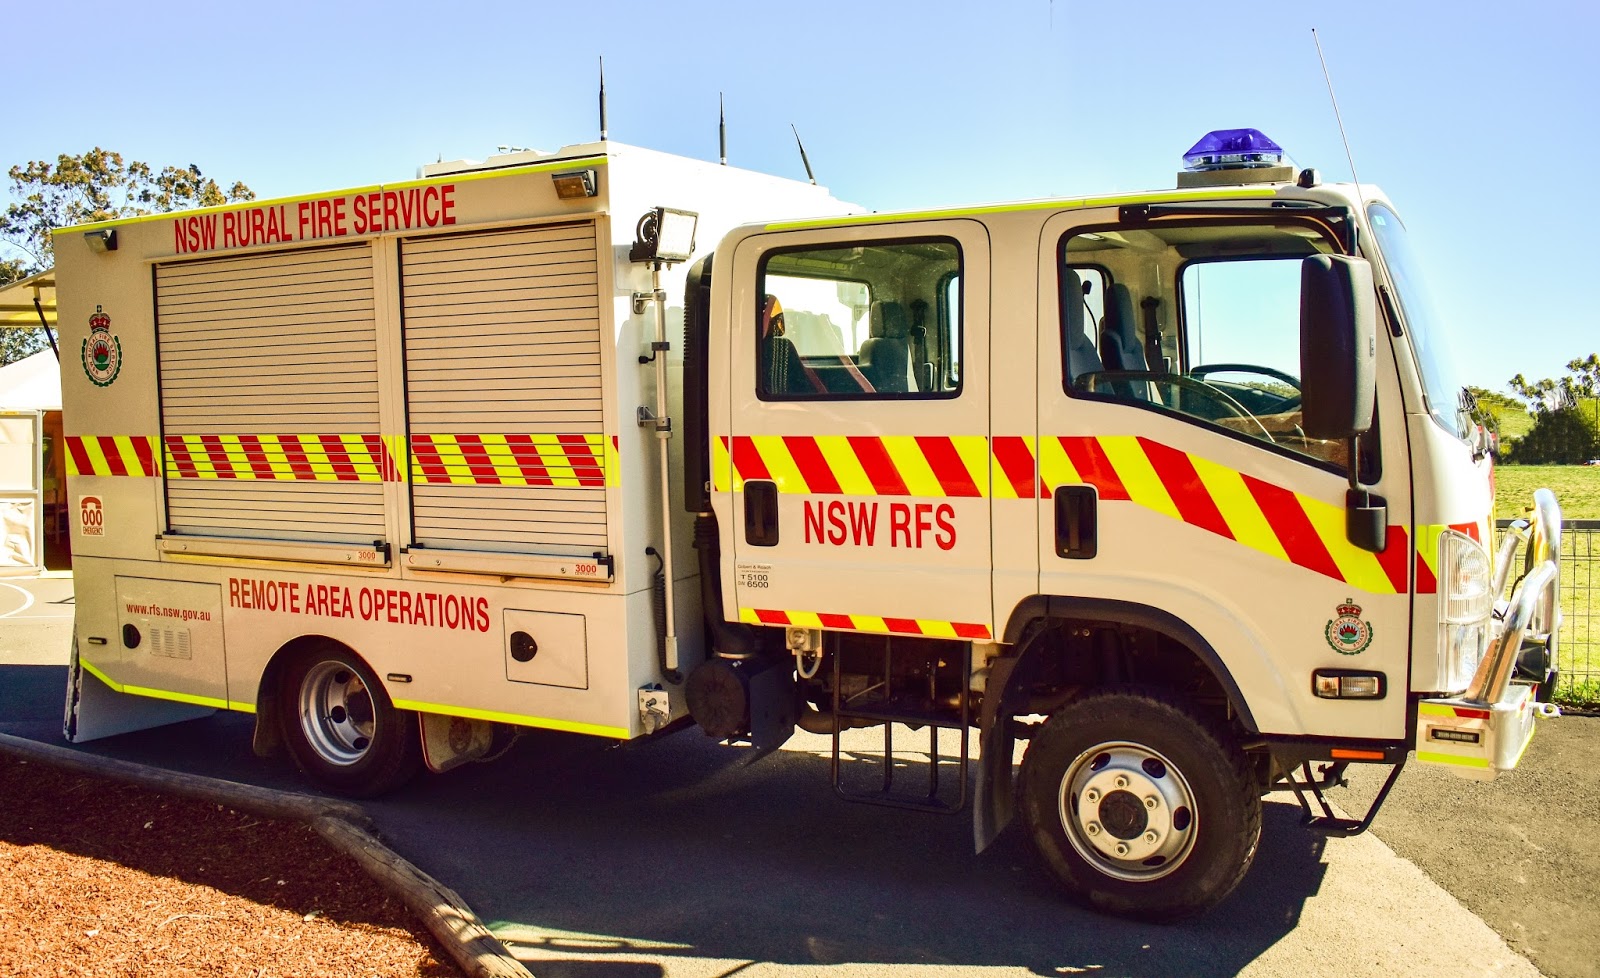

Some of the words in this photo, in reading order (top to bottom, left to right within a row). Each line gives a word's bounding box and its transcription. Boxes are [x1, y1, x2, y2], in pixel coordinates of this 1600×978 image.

[175, 214, 217, 254] NSW
[223, 205, 293, 249] RURAL
[298, 197, 348, 240] FIRE
[353, 184, 457, 235] SERVICE
[82, 509, 103, 526] 000
[803, 500, 879, 547] NSW
[889, 502, 957, 551] RFS
[358, 551, 376, 560] 3000
[575, 564, 597, 573] 3000
[747, 573, 768, 581] 5100
[126, 603, 211, 621] www.rfs.nsw.gov.au
[229, 577, 301, 614] REMOTE
[305, 583, 354, 619] AREA
[359, 586, 491, 633] OPERATIONS
